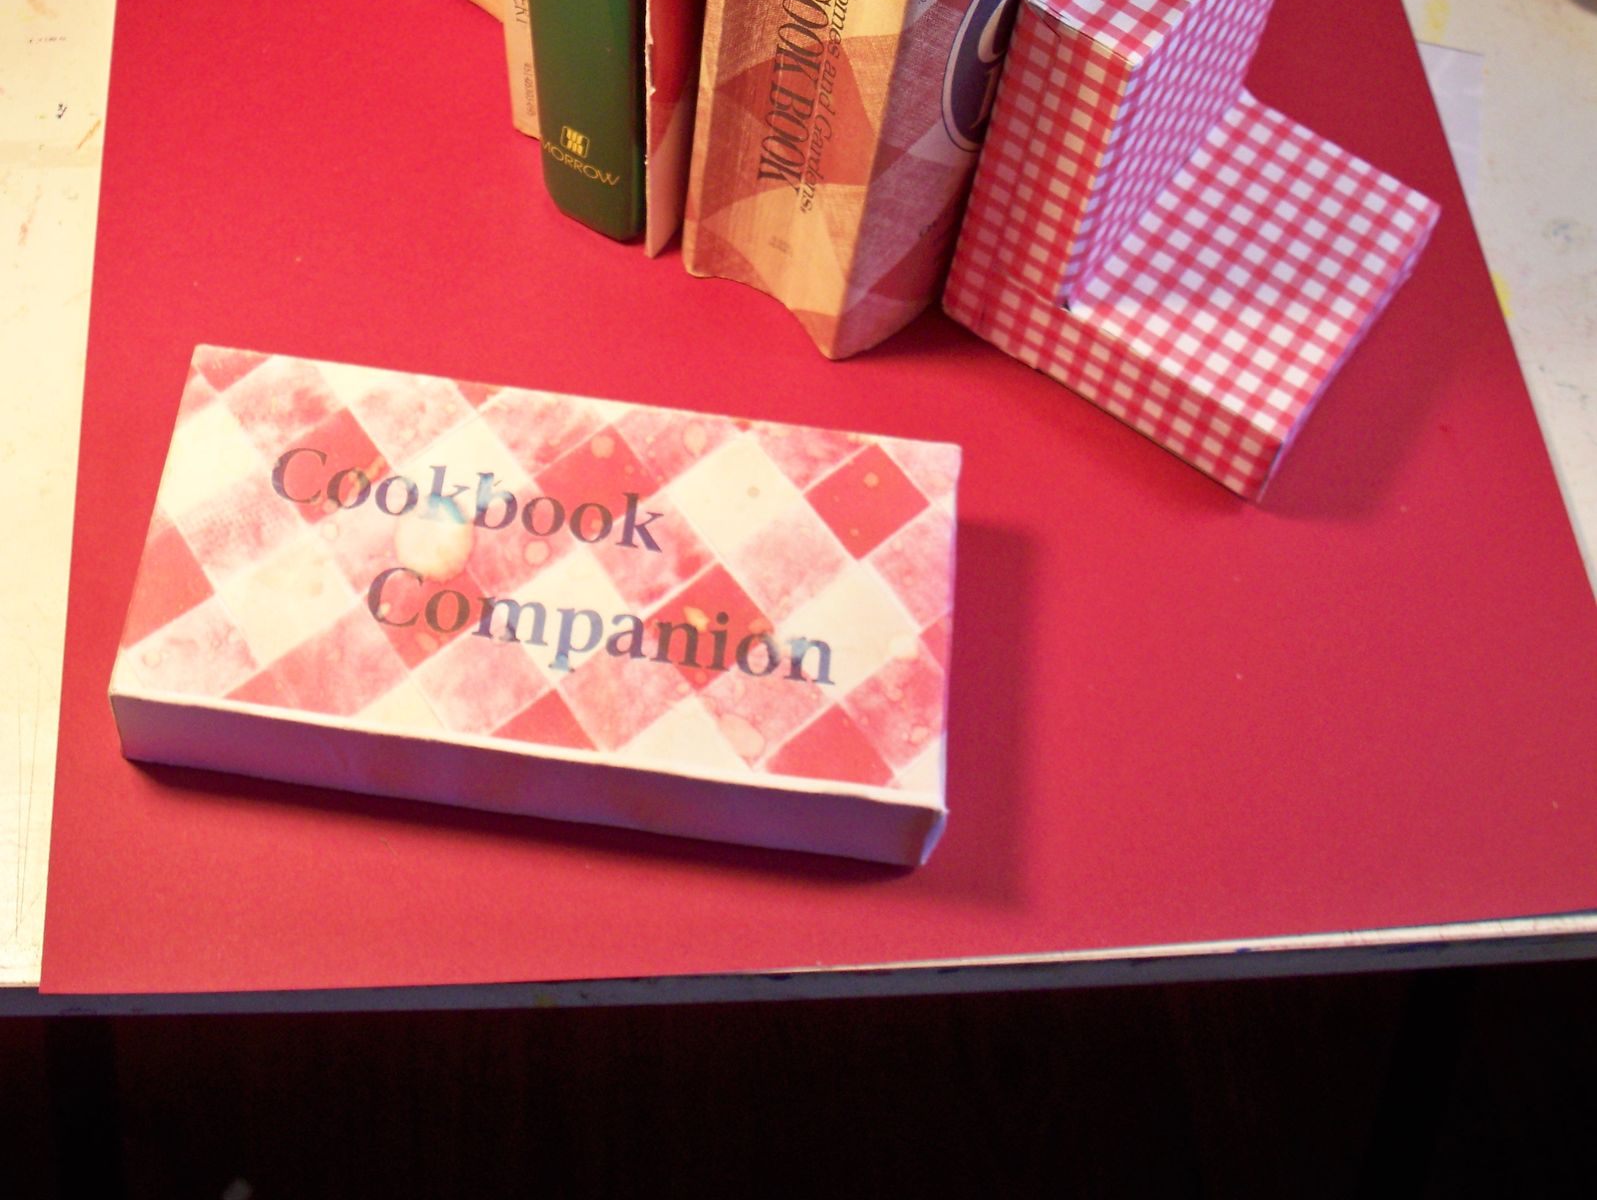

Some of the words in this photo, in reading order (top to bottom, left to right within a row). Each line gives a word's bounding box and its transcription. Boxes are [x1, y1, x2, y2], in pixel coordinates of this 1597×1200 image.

[757, 81, 815, 195] BOOK
[817, 57, 838, 116] and
[540, 138, 620, 188] MORROW
[270, 445, 665, 555] Cookbook
[366, 565, 836, 689] Companion
